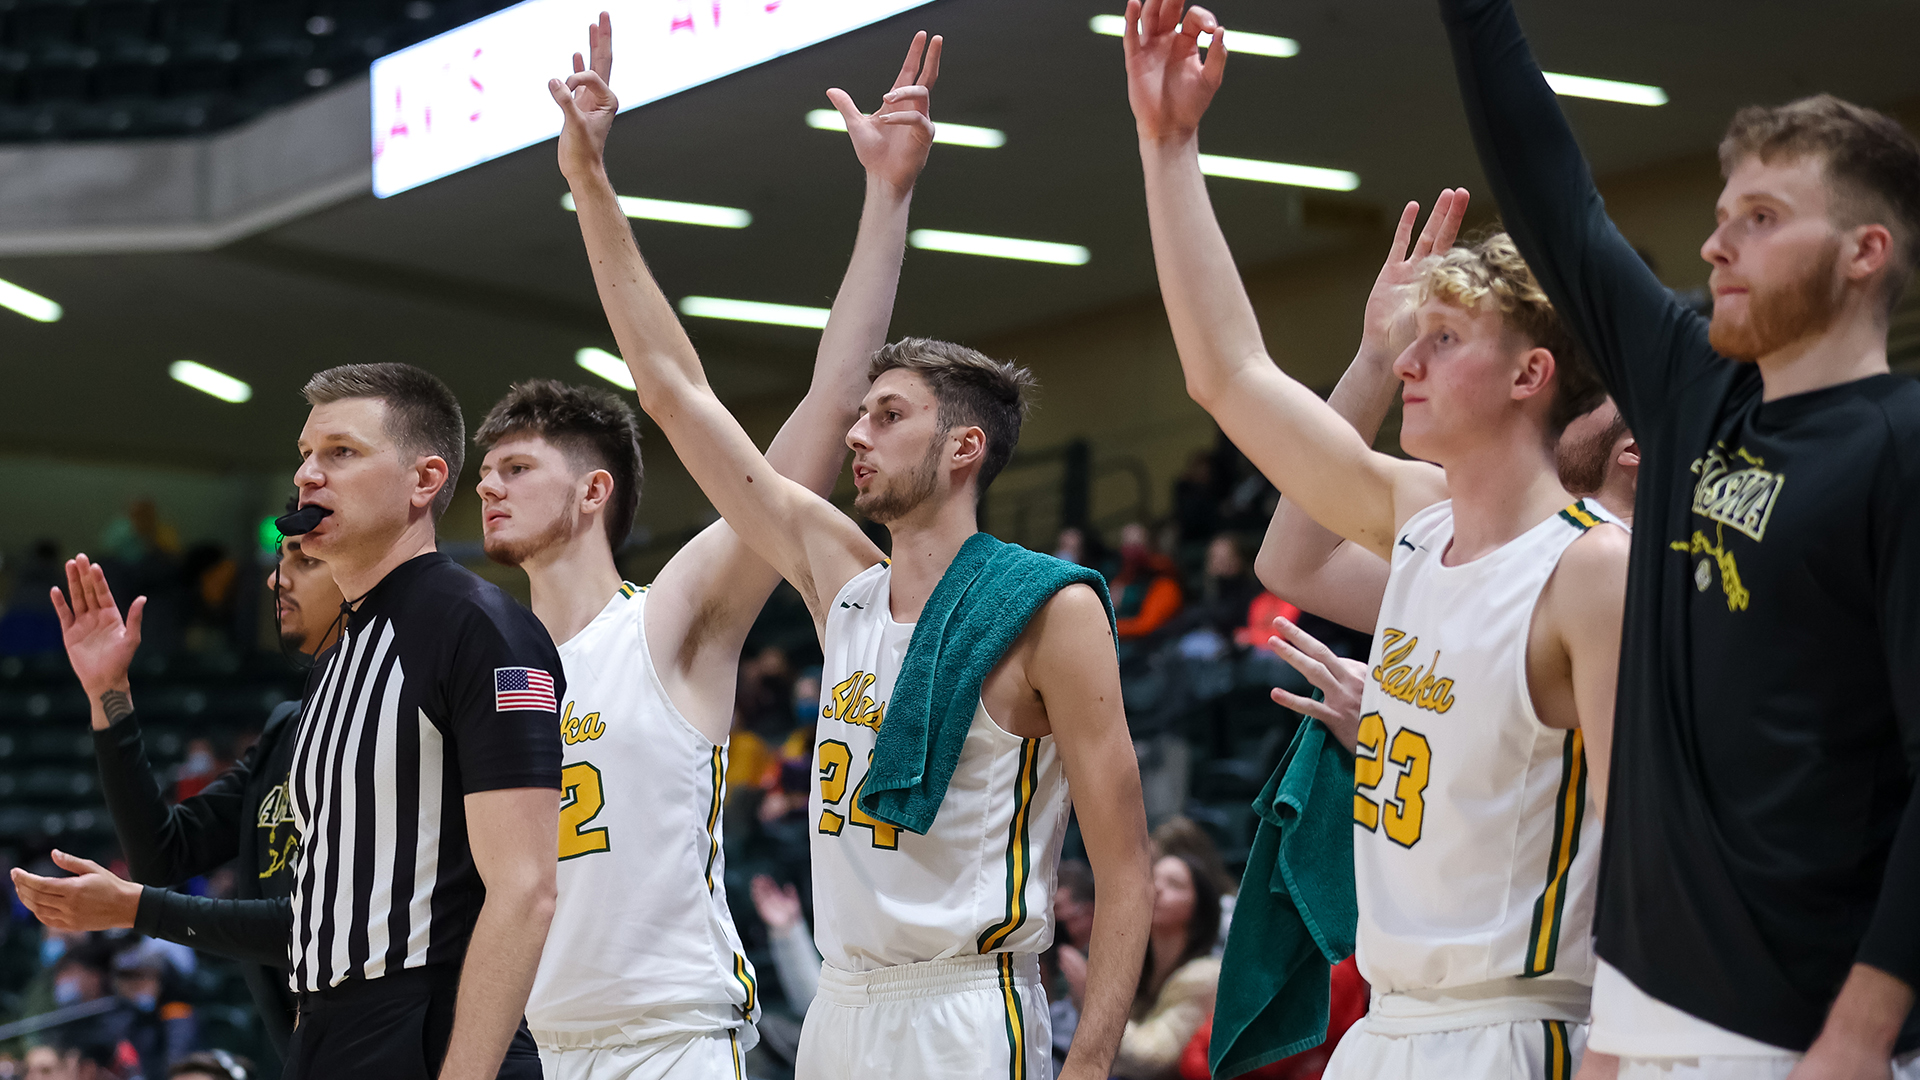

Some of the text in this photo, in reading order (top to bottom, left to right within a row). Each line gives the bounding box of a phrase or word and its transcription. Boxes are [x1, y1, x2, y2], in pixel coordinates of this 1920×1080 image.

[560, 701, 606, 745] ka
[823, 671, 885, 733] Alas
[1354, 711, 1431, 849] 23
